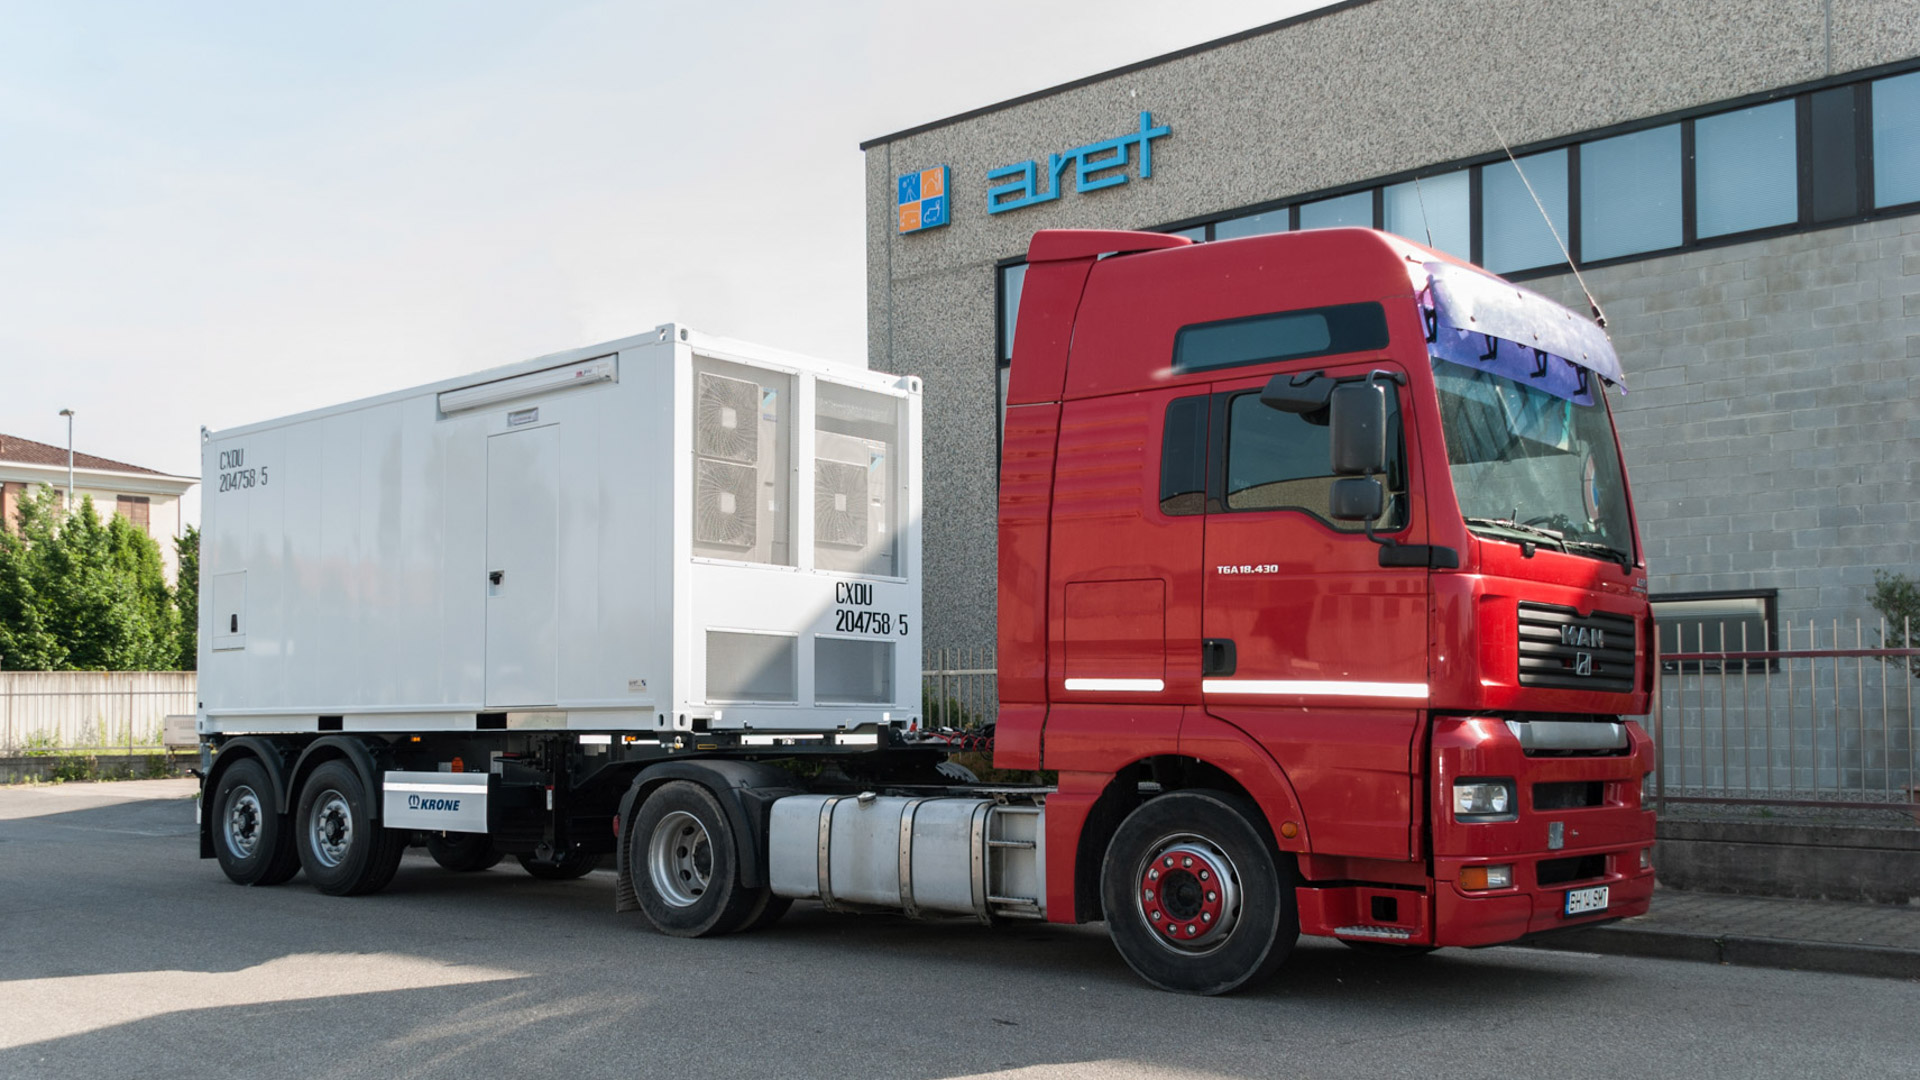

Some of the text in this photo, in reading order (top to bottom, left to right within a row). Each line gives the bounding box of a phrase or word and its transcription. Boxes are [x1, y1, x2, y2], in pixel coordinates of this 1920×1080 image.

[987, 110, 1173, 215] aret
[219, 448, 244, 471] CXDU
[835, 581, 873, 606] CXDU
[1561, 624, 1604, 649] MAN
[420, 798, 460, 812] KRONE
